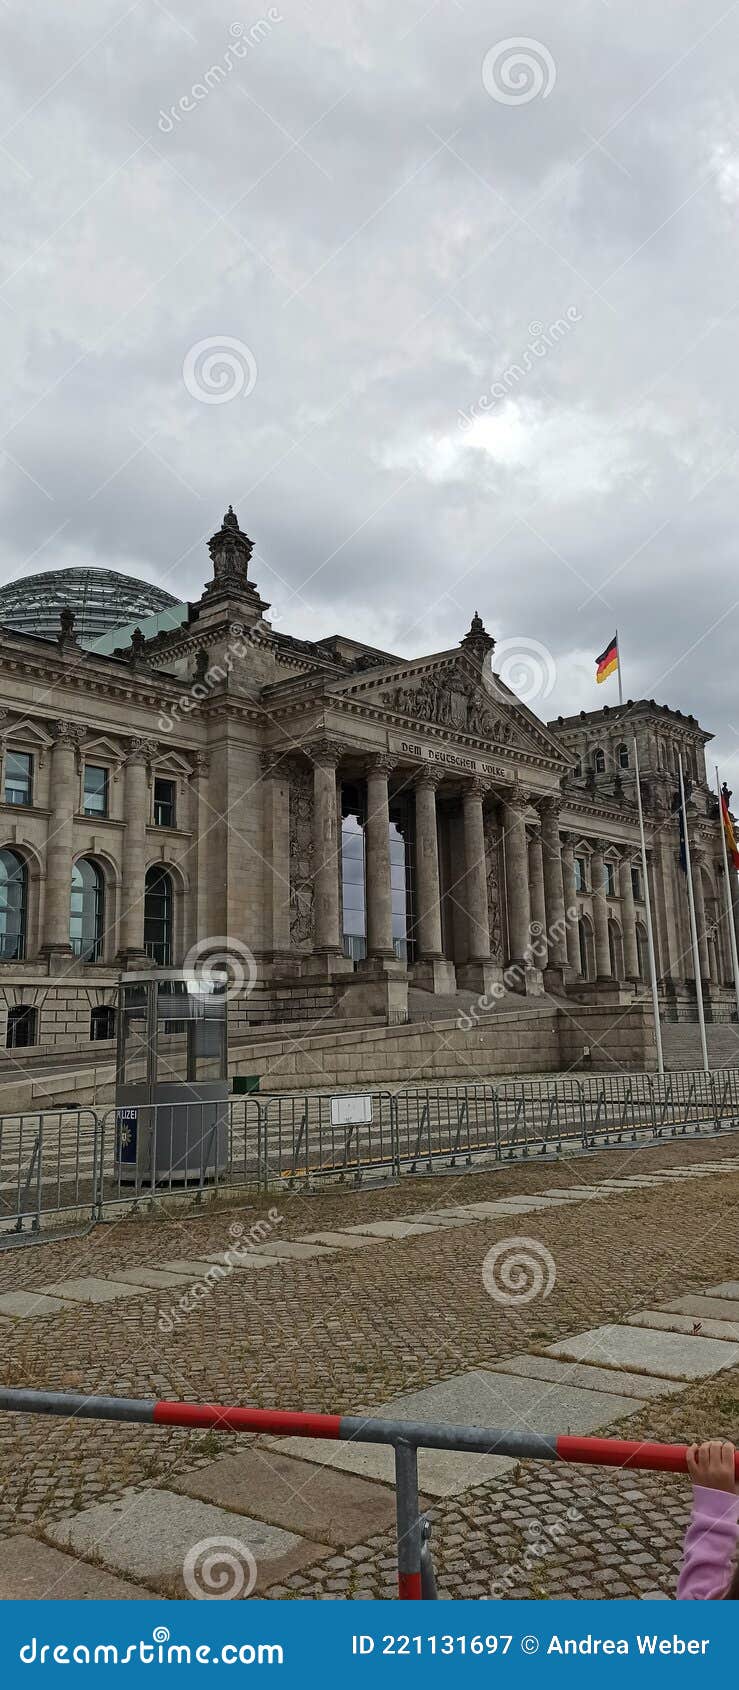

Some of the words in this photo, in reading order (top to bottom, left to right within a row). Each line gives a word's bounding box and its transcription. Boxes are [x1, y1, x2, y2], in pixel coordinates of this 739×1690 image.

[401, 742, 422, 756] DEM
[428, 749, 477, 770] DEUTSCHEN
[481, 763, 505, 777] VOLKE
